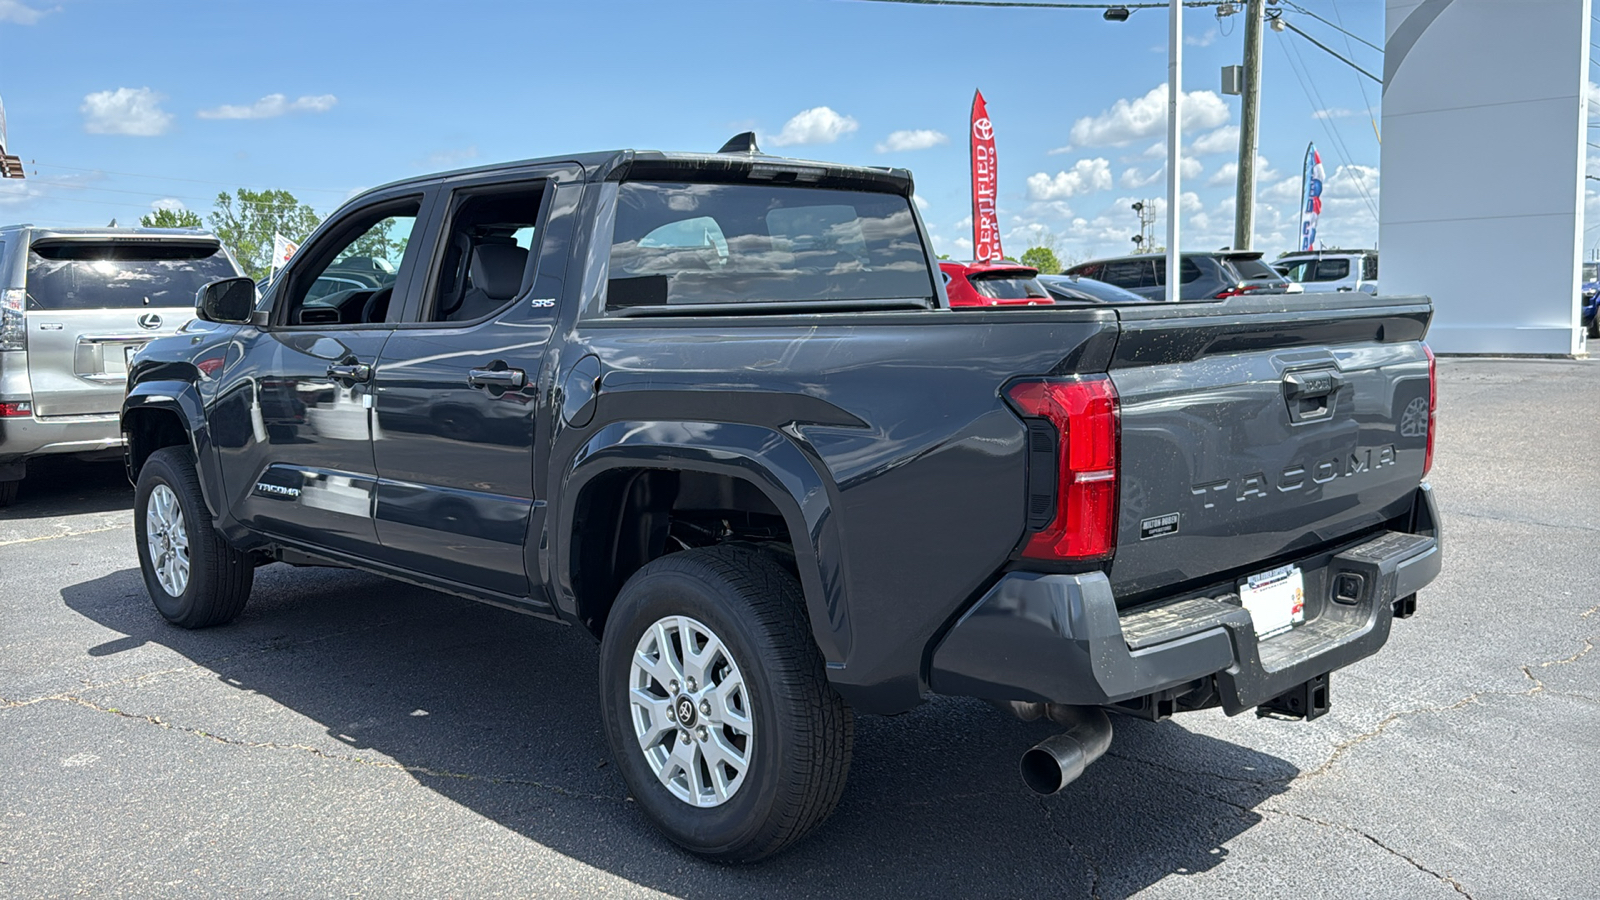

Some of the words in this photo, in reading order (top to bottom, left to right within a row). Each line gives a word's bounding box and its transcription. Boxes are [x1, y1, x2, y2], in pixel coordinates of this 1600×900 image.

[977, 145, 991, 261] CERTIFIED
[257, 482, 302, 497] TACOMA
[1190, 443, 1396, 509] TACOMA
